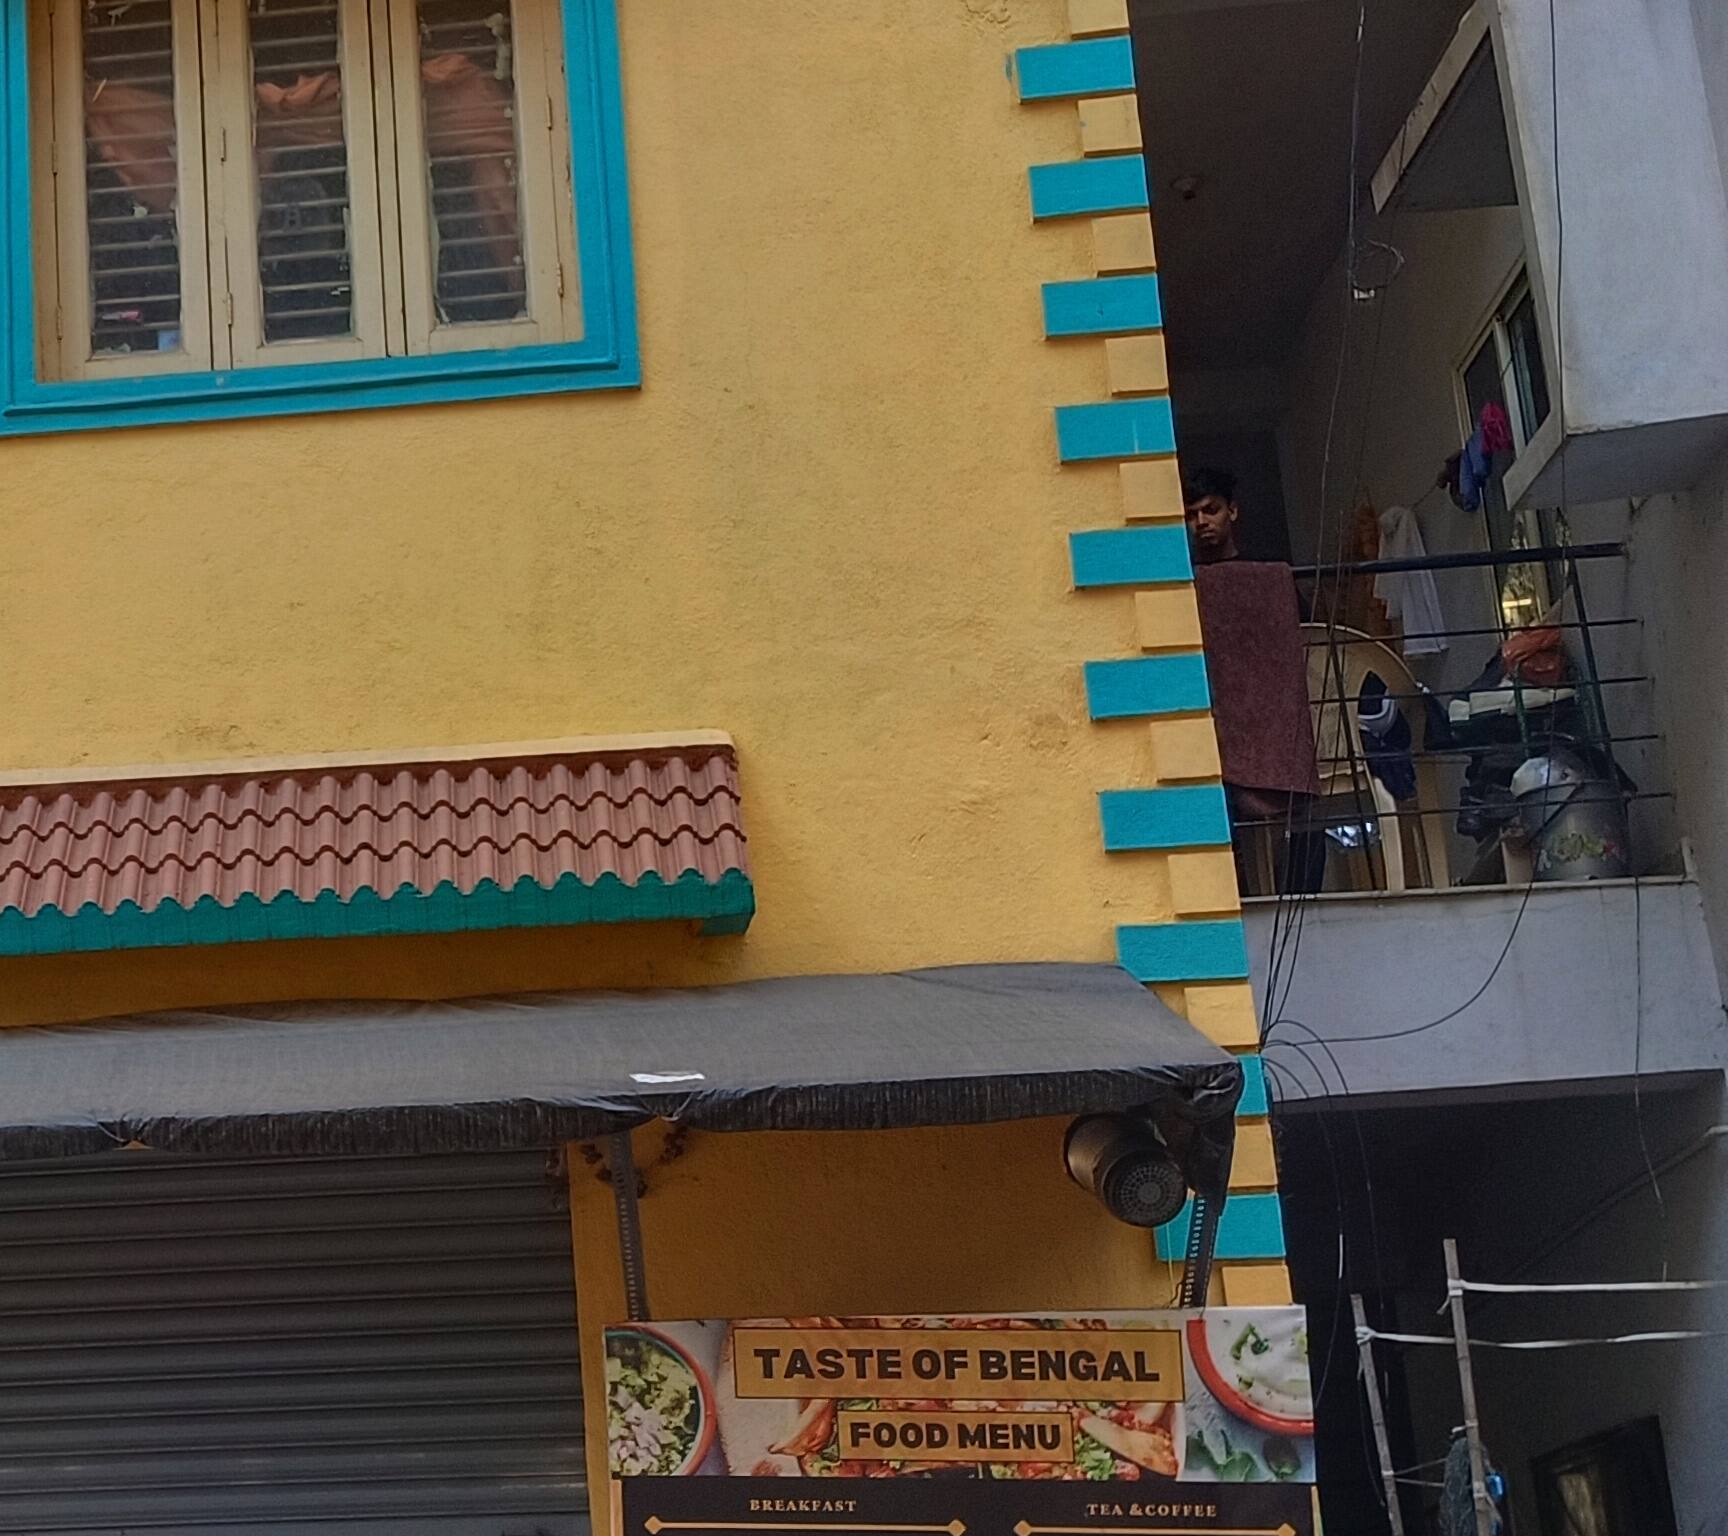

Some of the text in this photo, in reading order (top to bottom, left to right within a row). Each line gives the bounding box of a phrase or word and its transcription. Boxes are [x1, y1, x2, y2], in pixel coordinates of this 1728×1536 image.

[754, 1347, 1160, 1382] TASTE OF BENGAL
[850, 1421, 1062, 1451] FOOD MENU
[750, 1499, 857, 1512] BREAKFAST
